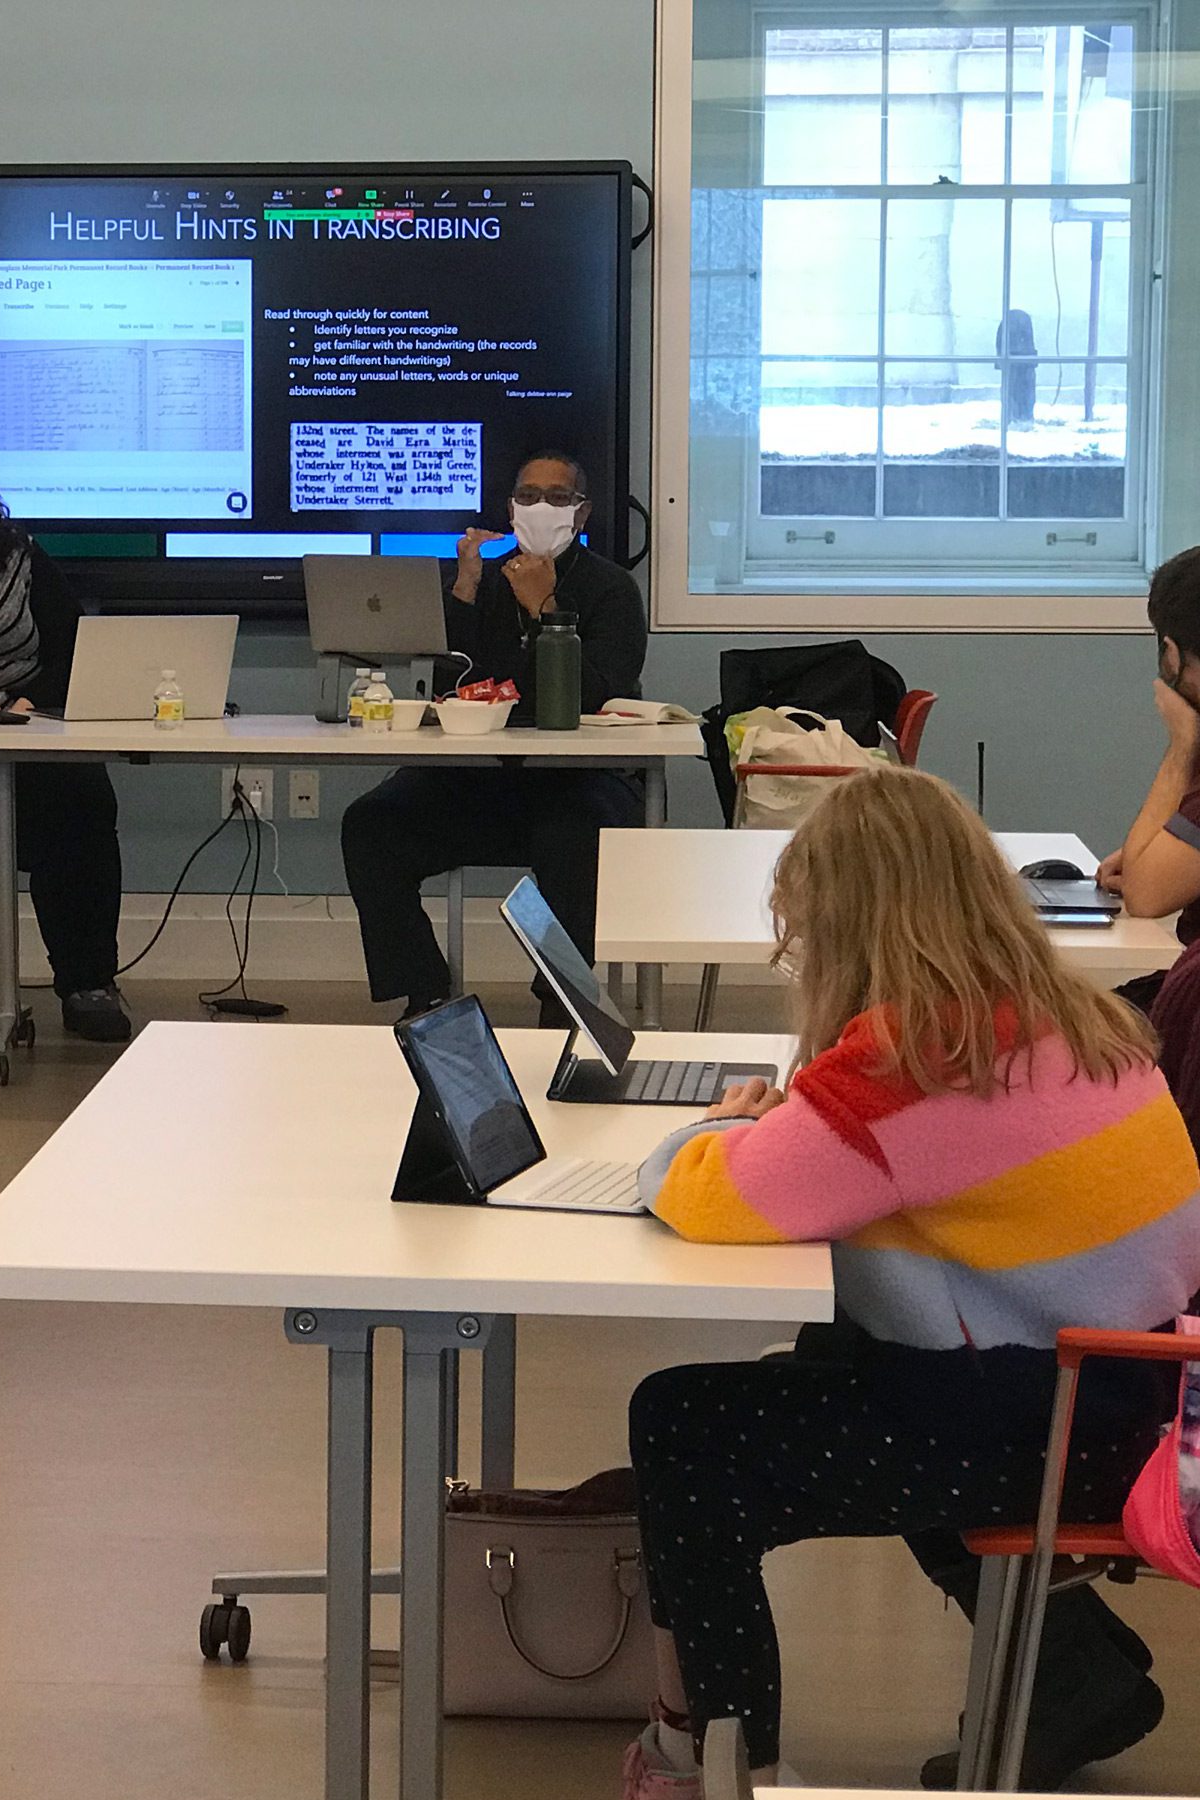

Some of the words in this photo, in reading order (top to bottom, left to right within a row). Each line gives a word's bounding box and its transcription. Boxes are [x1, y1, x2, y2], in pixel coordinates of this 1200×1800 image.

[50, 211, 164, 240] HELPFUL
[176, 211, 257, 240] HINTS
[16, 278, 45, 292] Page
[264, 309, 291, 320] Read
[293, 309, 333, 322] through
[335, 309, 370, 322] quickly
[373, 308, 387, 319] for
[390, 310, 429, 319] content
[314, 324, 351, 337] Identify
[354, 325, 385, 334] letters
[388, 327, 407, 337] you
[409, 325, 458, 337] recognize
[314, 341, 332, 352] get
[334, 339, 370, 350] familiar
[373, 340, 394, 350] with
[397, 340, 413, 350] the
[416, 340, 475, 352] handwriting
[477, 340, 497, 351] (the
[499, 340, 537, 350] records
[289, 357, 310, 367] may
[313, 355, 337, 365] have
[339, 355, 381, 365] different
[384, 355, 451, 367] handwritings)
[314, 371, 337, 381] note
[340, 373, 357, 383] any
[360, 370, 398, 381] unusual
[401, 370, 435, 382] letters,
[438, 370, 469, 381] words
[471, 373, 482, 381] or
[484, 370, 519, 383] unique
[289, 386, 356, 396] abbreviations
[366, 425, 384, 435] The
[426, 425, 436, 435] of
[442, 425, 455, 435] the
[461, 426, 476, 435] de-
[295, 438, 326, 448] ceased
[337, 439, 352, 447] are
[366, 436, 394, 447] David
[295, 448, 325, 458] whose
[336, 448, 381, 458] interment
[411, 448, 453, 460] arranged
[464, 448, 476, 460] by
[391, 461, 407, 470] and
[413, 460, 442, 470] David
[296, 471, 336, 483] formerly
[343, 471, 353, 482] of
[362, 472, 376, 482] 121
[385, 472, 407, 482] West
[295, 483, 325, 493] whose
[333, 483, 379, 493] interment
[386, 486, 403, 494] was
[411, 483, 453, 495] arranged
[464, 483, 476, 495] by
[295, 494, 349, 505] Undertaker
